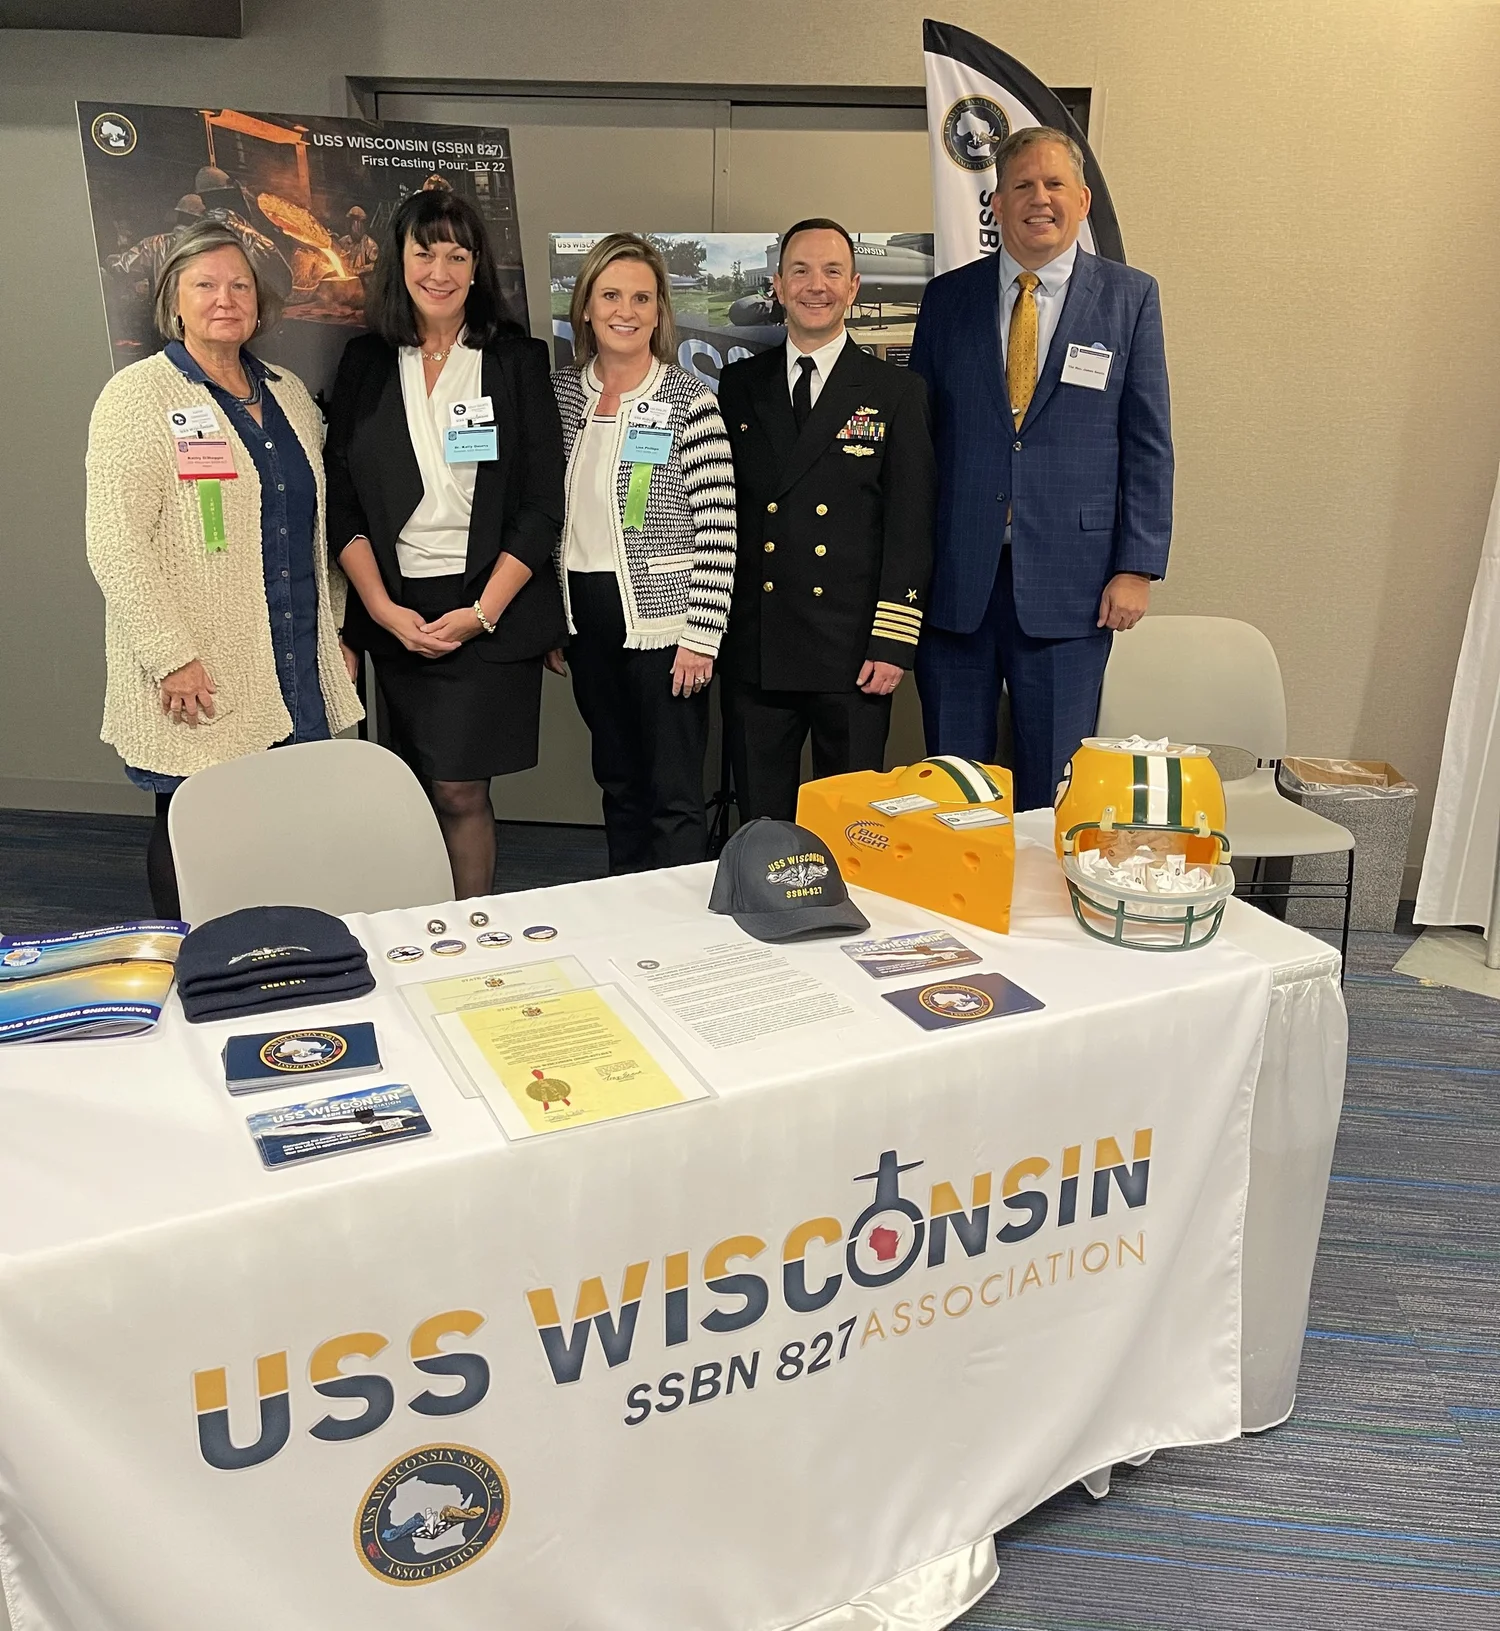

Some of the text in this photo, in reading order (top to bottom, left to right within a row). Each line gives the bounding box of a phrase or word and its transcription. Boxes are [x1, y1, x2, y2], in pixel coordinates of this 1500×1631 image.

[313, 133, 504, 159] USS WISCONSIN (SSBN 827)
[361, 155, 505, 173] First Casting Pour: FY 22
[573, 239, 596, 249] WISCO
[853, 245, 886, 256] CONSIN
[850, 832, 890, 849] LIGHT
[858, 828, 889, 843] BUD
[767, 852, 825, 872] USS WISCONSIN
[786, 886, 823, 899] SSBN-827
[25, 1010, 81, 1026] UNDERSEA
[82, 1006, 152, 1015] MAINTAINING
[272, 1092, 400, 1124] USS WISCONSIN
[193, 1128, 1153, 1471] USS WISCONSIN
[623, 1232, 1146, 1426] SSBN 827 ASSOCIATION
[371, 1450, 456, 1500] WISCONSIN
[458, 1454, 493, 1480] SSBN
[488, 1480, 502, 1500] 827
[362, 1505, 377, 1534] USS
[384, 1538, 484, 1579] ASSOCIATION
